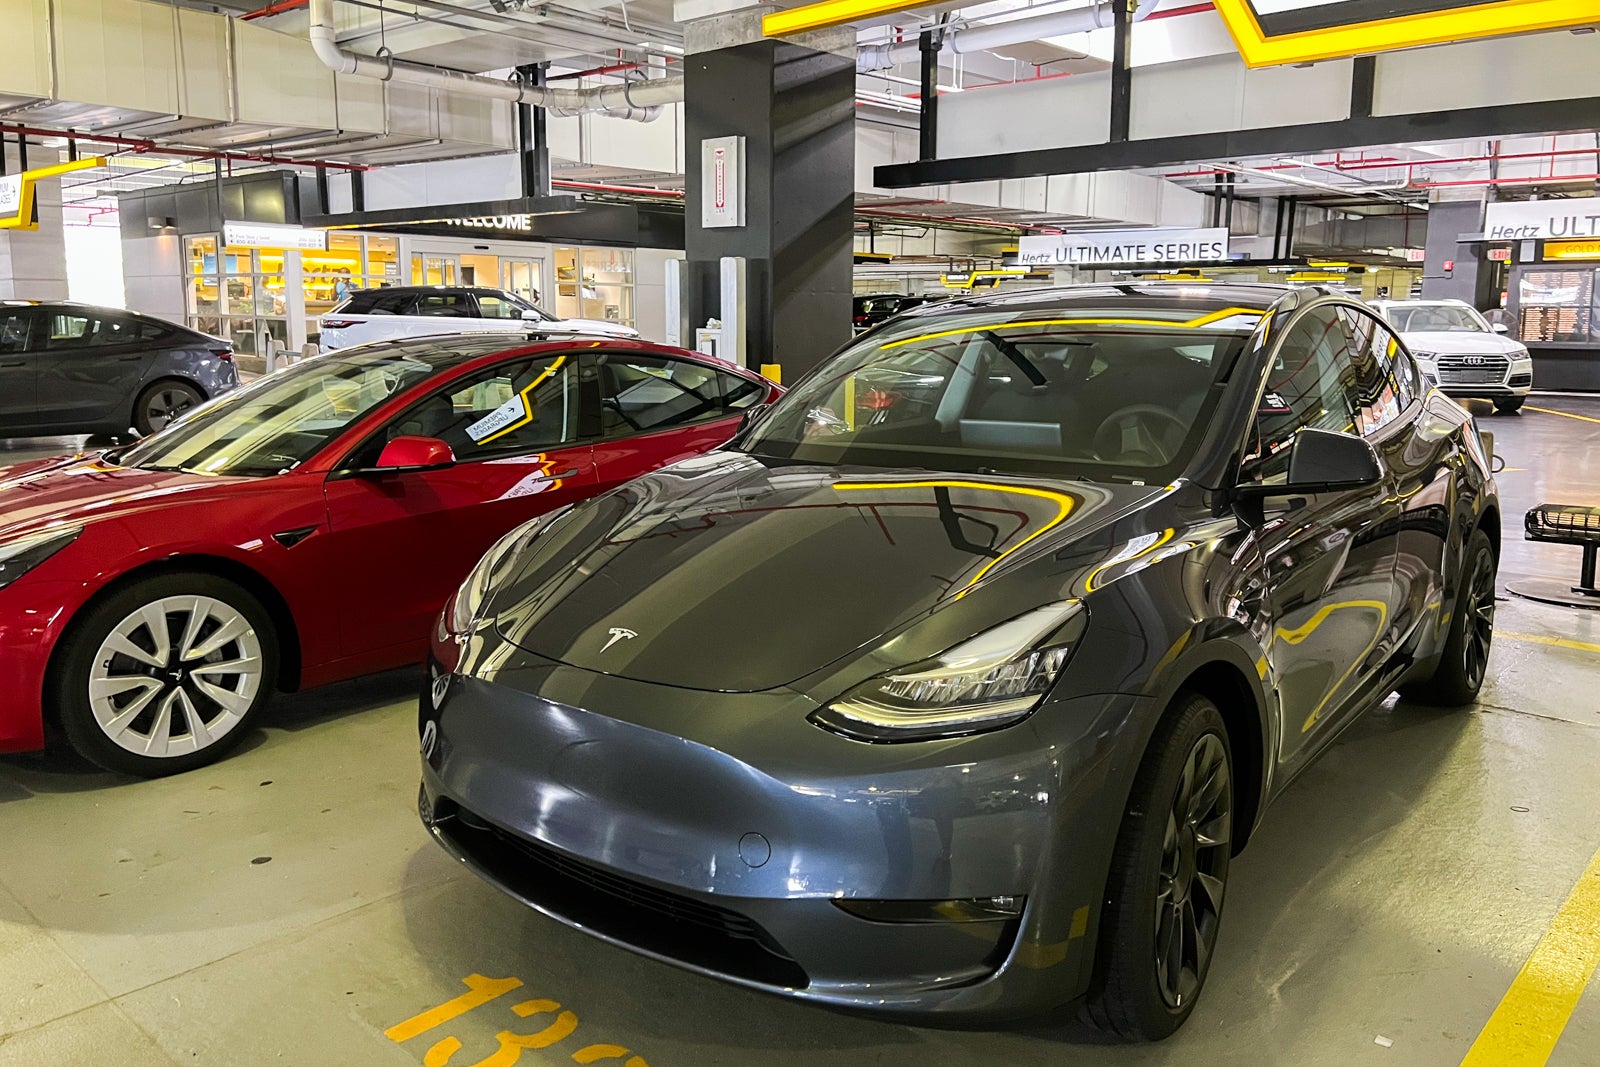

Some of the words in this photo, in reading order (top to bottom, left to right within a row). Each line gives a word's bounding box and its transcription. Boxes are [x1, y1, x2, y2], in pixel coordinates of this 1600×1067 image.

[1490, 225, 1540, 238] Hertz
[1549, 215, 1600, 237] ULT
[1021, 254, 1051, 264] Hertz
[1056, 245, 1146, 263] ULTIMATE
[1153, 242, 1222, 260] SERIES
[1565, 244, 1594, 253] GOLD
[384, 974, 650, 1067] 13
